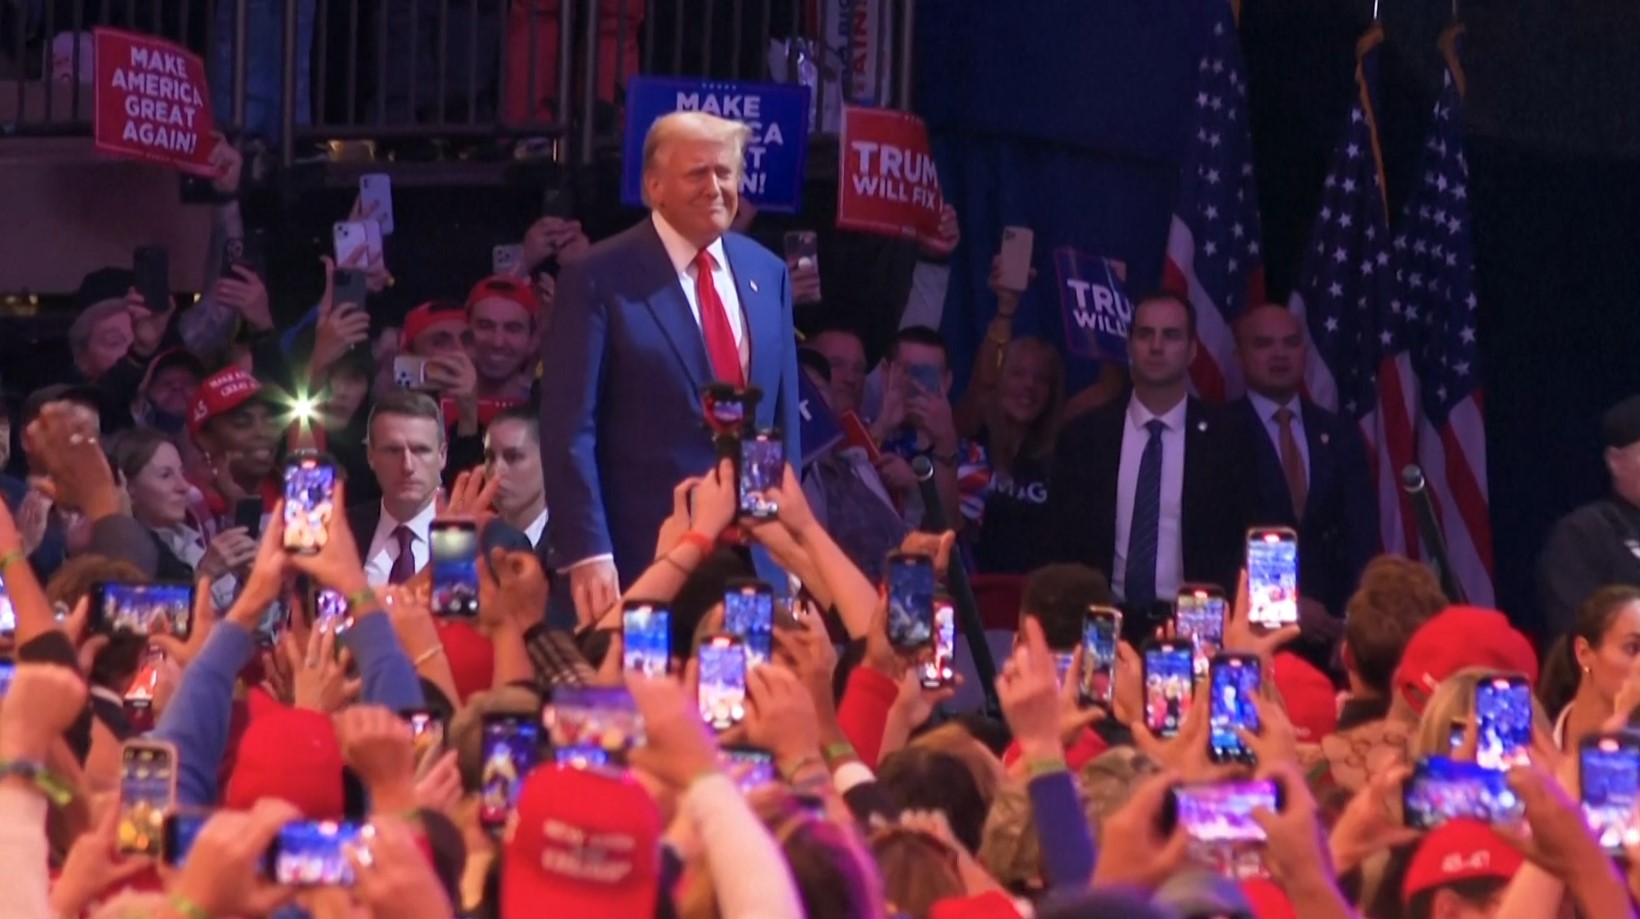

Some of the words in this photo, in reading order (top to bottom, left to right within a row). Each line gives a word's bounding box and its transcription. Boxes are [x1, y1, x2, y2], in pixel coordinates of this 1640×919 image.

[130, 45, 188, 79] MAKE
[112, 67, 203, 107] AMERICA
[676, 91, 761, 118] MAKE
[125, 95, 196, 128] GREAT
[123, 120, 197, 154] AGAIN!
[851, 141, 939, 190] TRUM
[852, 174, 908, 201] WILL
[913, 186, 936, 210] FIX
[1067, 279, 1132, 324] TRU
